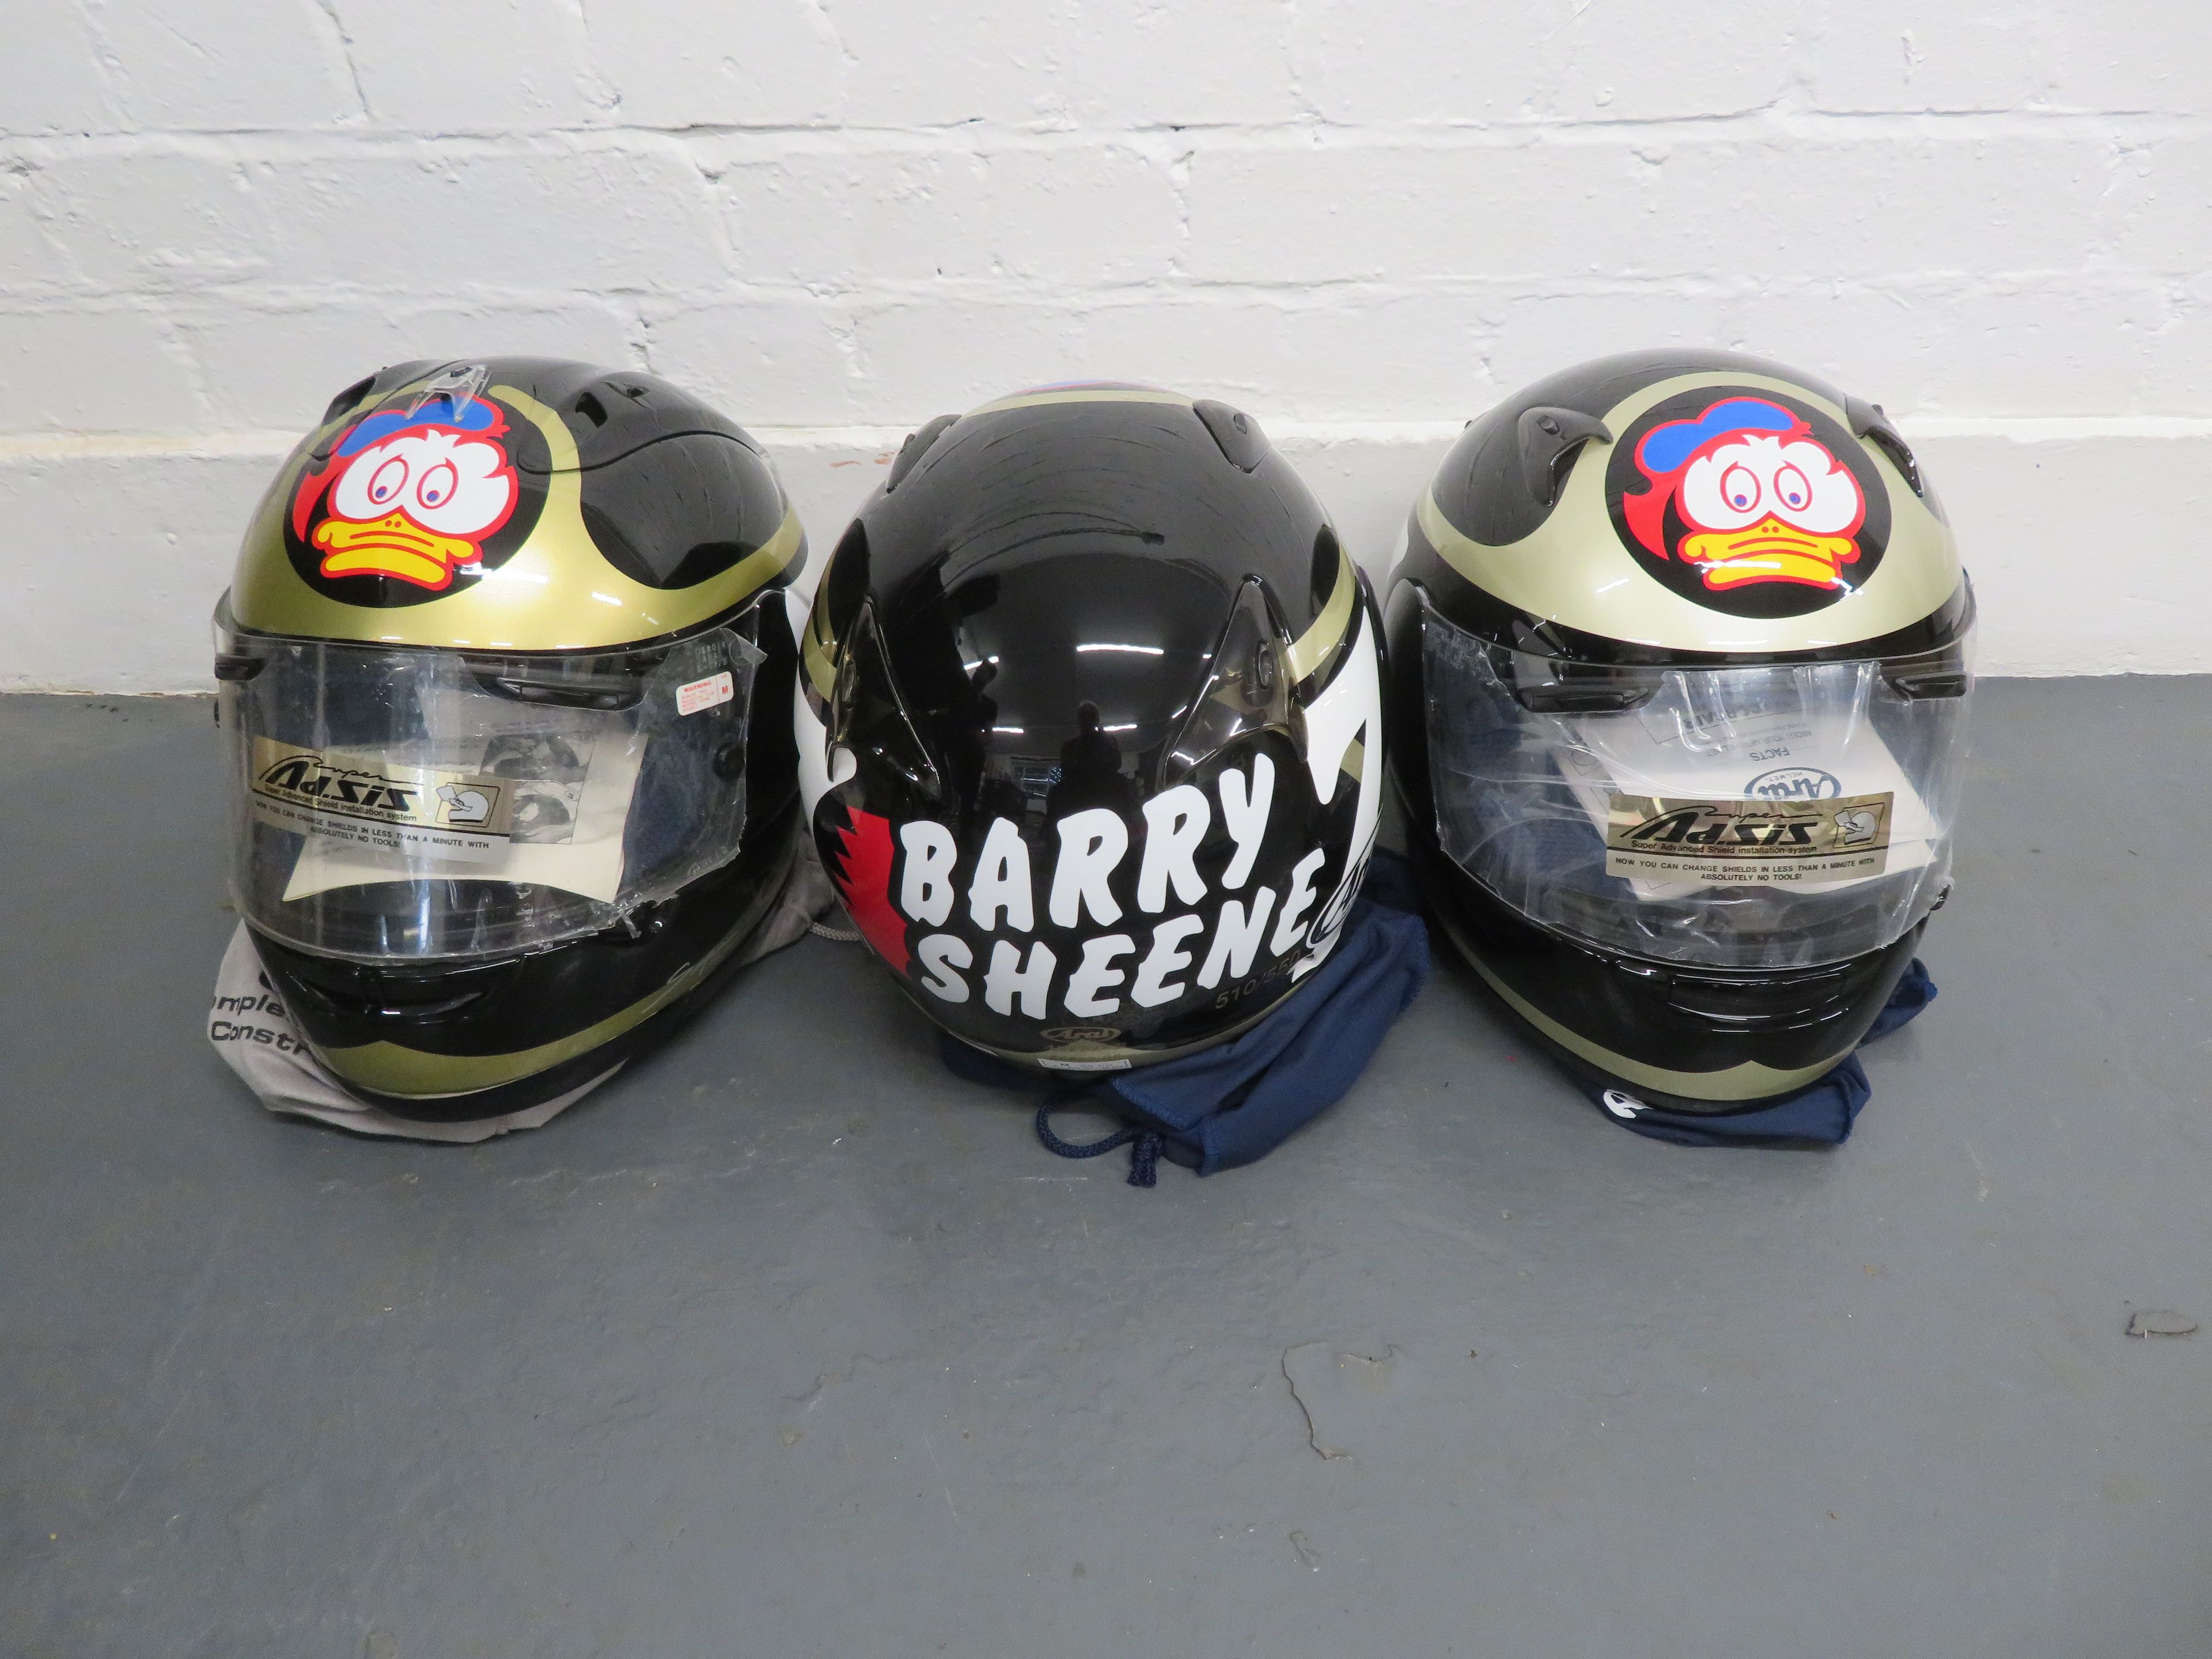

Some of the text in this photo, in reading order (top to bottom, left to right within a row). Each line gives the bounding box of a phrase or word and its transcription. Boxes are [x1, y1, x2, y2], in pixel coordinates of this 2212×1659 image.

[683, 680, 712, 693] WARNING
[721, 685, 729, 695] M
[1749, 747, 1790, 762] FACTS
[315, 797, 339, 809] Shield
[341, 801, 384, 817] installation
[387, 811, 417, 822] system
[297, 813, 324, 825] CHANGE
[327, 820, 358, 833] SHIELDS
[372, 829, 392, 838] LESS
[396, 833, 419, 842] THAN
[432, 837, 463, 847] MINUTE
[467, 841, 490, 849] WITH
[310, 826, 354, 840] ABSOLUTELY
[357, 835, 369, 843] NO
[899, 752, 1275, 933] BARRY
[1631, 840, 1657, 850] Super
[1660, 843, 1705, 853] Advanced
[1707, 846, 1735, 854] Shield
[1788, 846, 1817, 854] system
[1615, 857, 1635, 865] NOW
[1682, 864, 1718, 872] CHANGE
[1830, 860, 1855, 869] MINUTE
[1700, 873, 1753, 881] ABSOLUTELY
[917, 848, 1325, 1020] SHEENE
